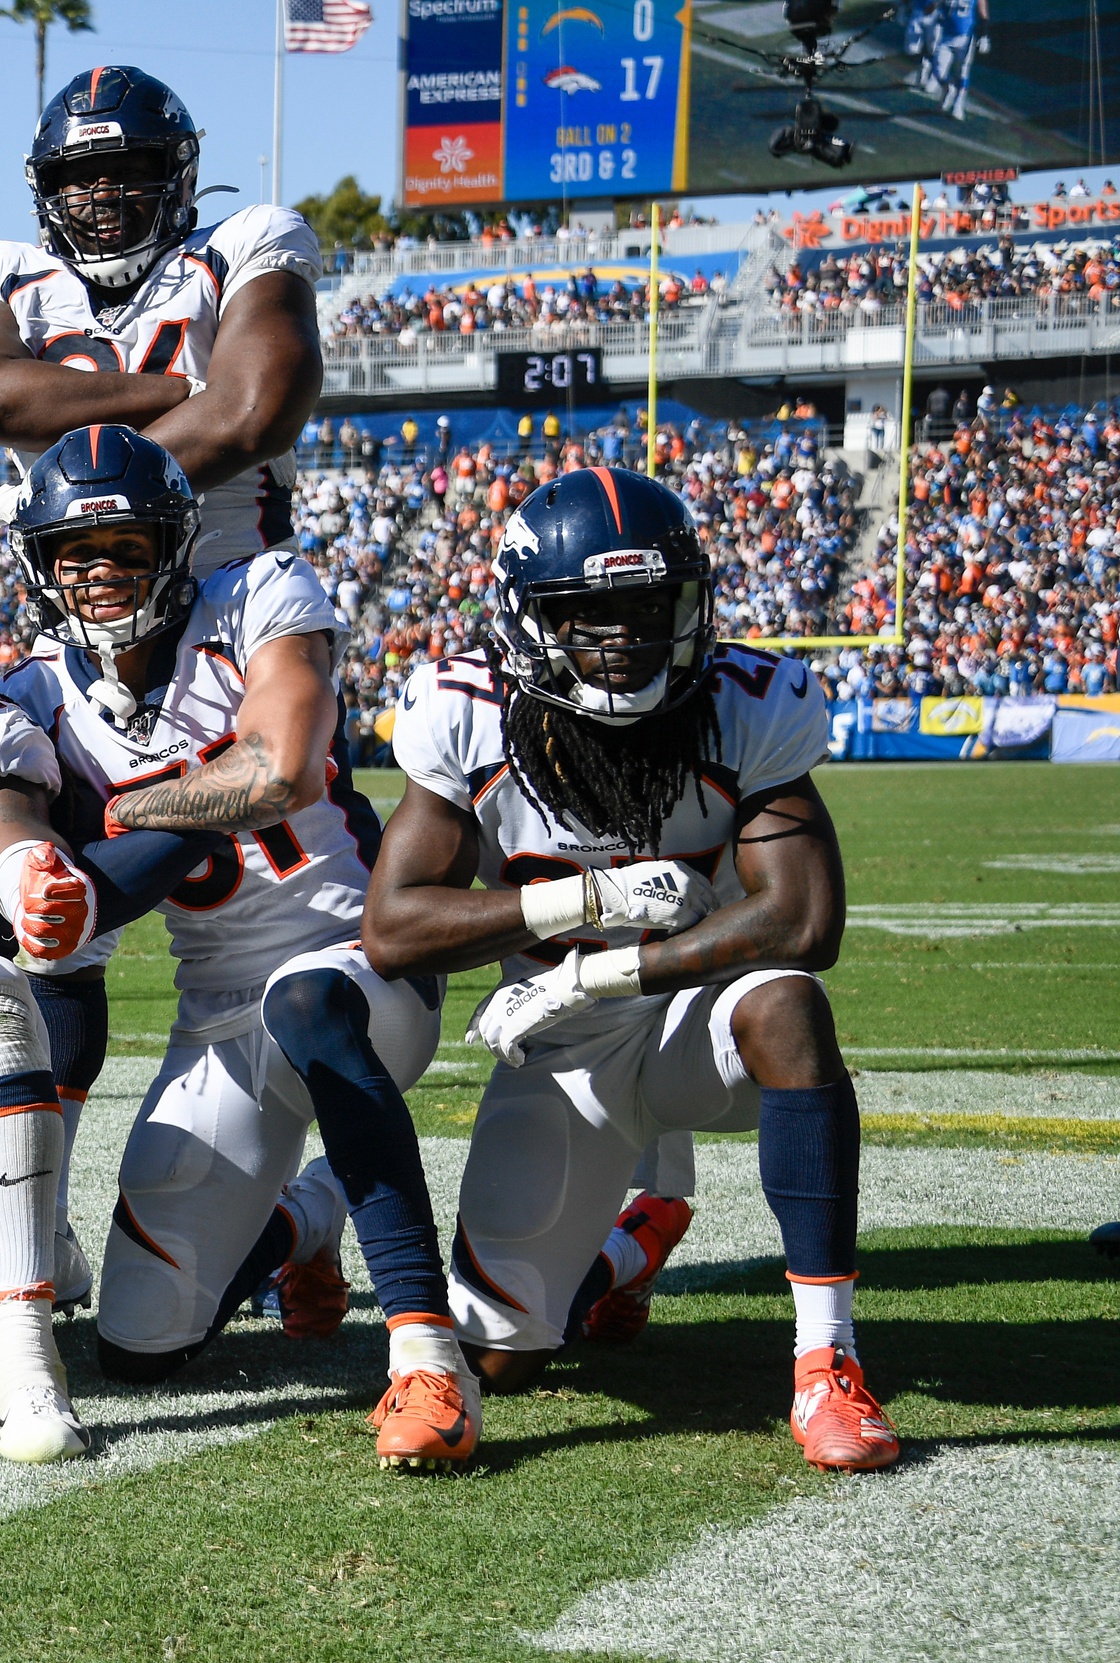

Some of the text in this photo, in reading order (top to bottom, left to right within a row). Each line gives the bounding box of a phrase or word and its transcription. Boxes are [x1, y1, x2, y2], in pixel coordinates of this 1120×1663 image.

[408, 0, 498, 19] Spectrum
[633, 0, 654, 42] 0
[407, 71, 500, 91] AMERICAN
[620, 55, 663, 101] 17
[419, 87, 501, 104] EXPRESS
[79, 125, 110, 137] BRONCOS
[556, 123, 631, 147] BALL ON 2
[549, 149, 637, 184] 3RD & 2
[943, 167, 1017, 185] TOSHIBA
[405, 173, 498, 194] Dignity Health
[1034, 198, 1120, 231] Sports
[841, 212, 935, 243] Digniy
[524, 353, 596, 389] 2:07
[80, 498, 117, 513] BRONCOS
[603, 553, 644, 568] BRONCOS
[128, 739, 189, 768] BRONCOS
[632, 886, 685, 907] adidas
[506, 985, 547, 1017] adidas
